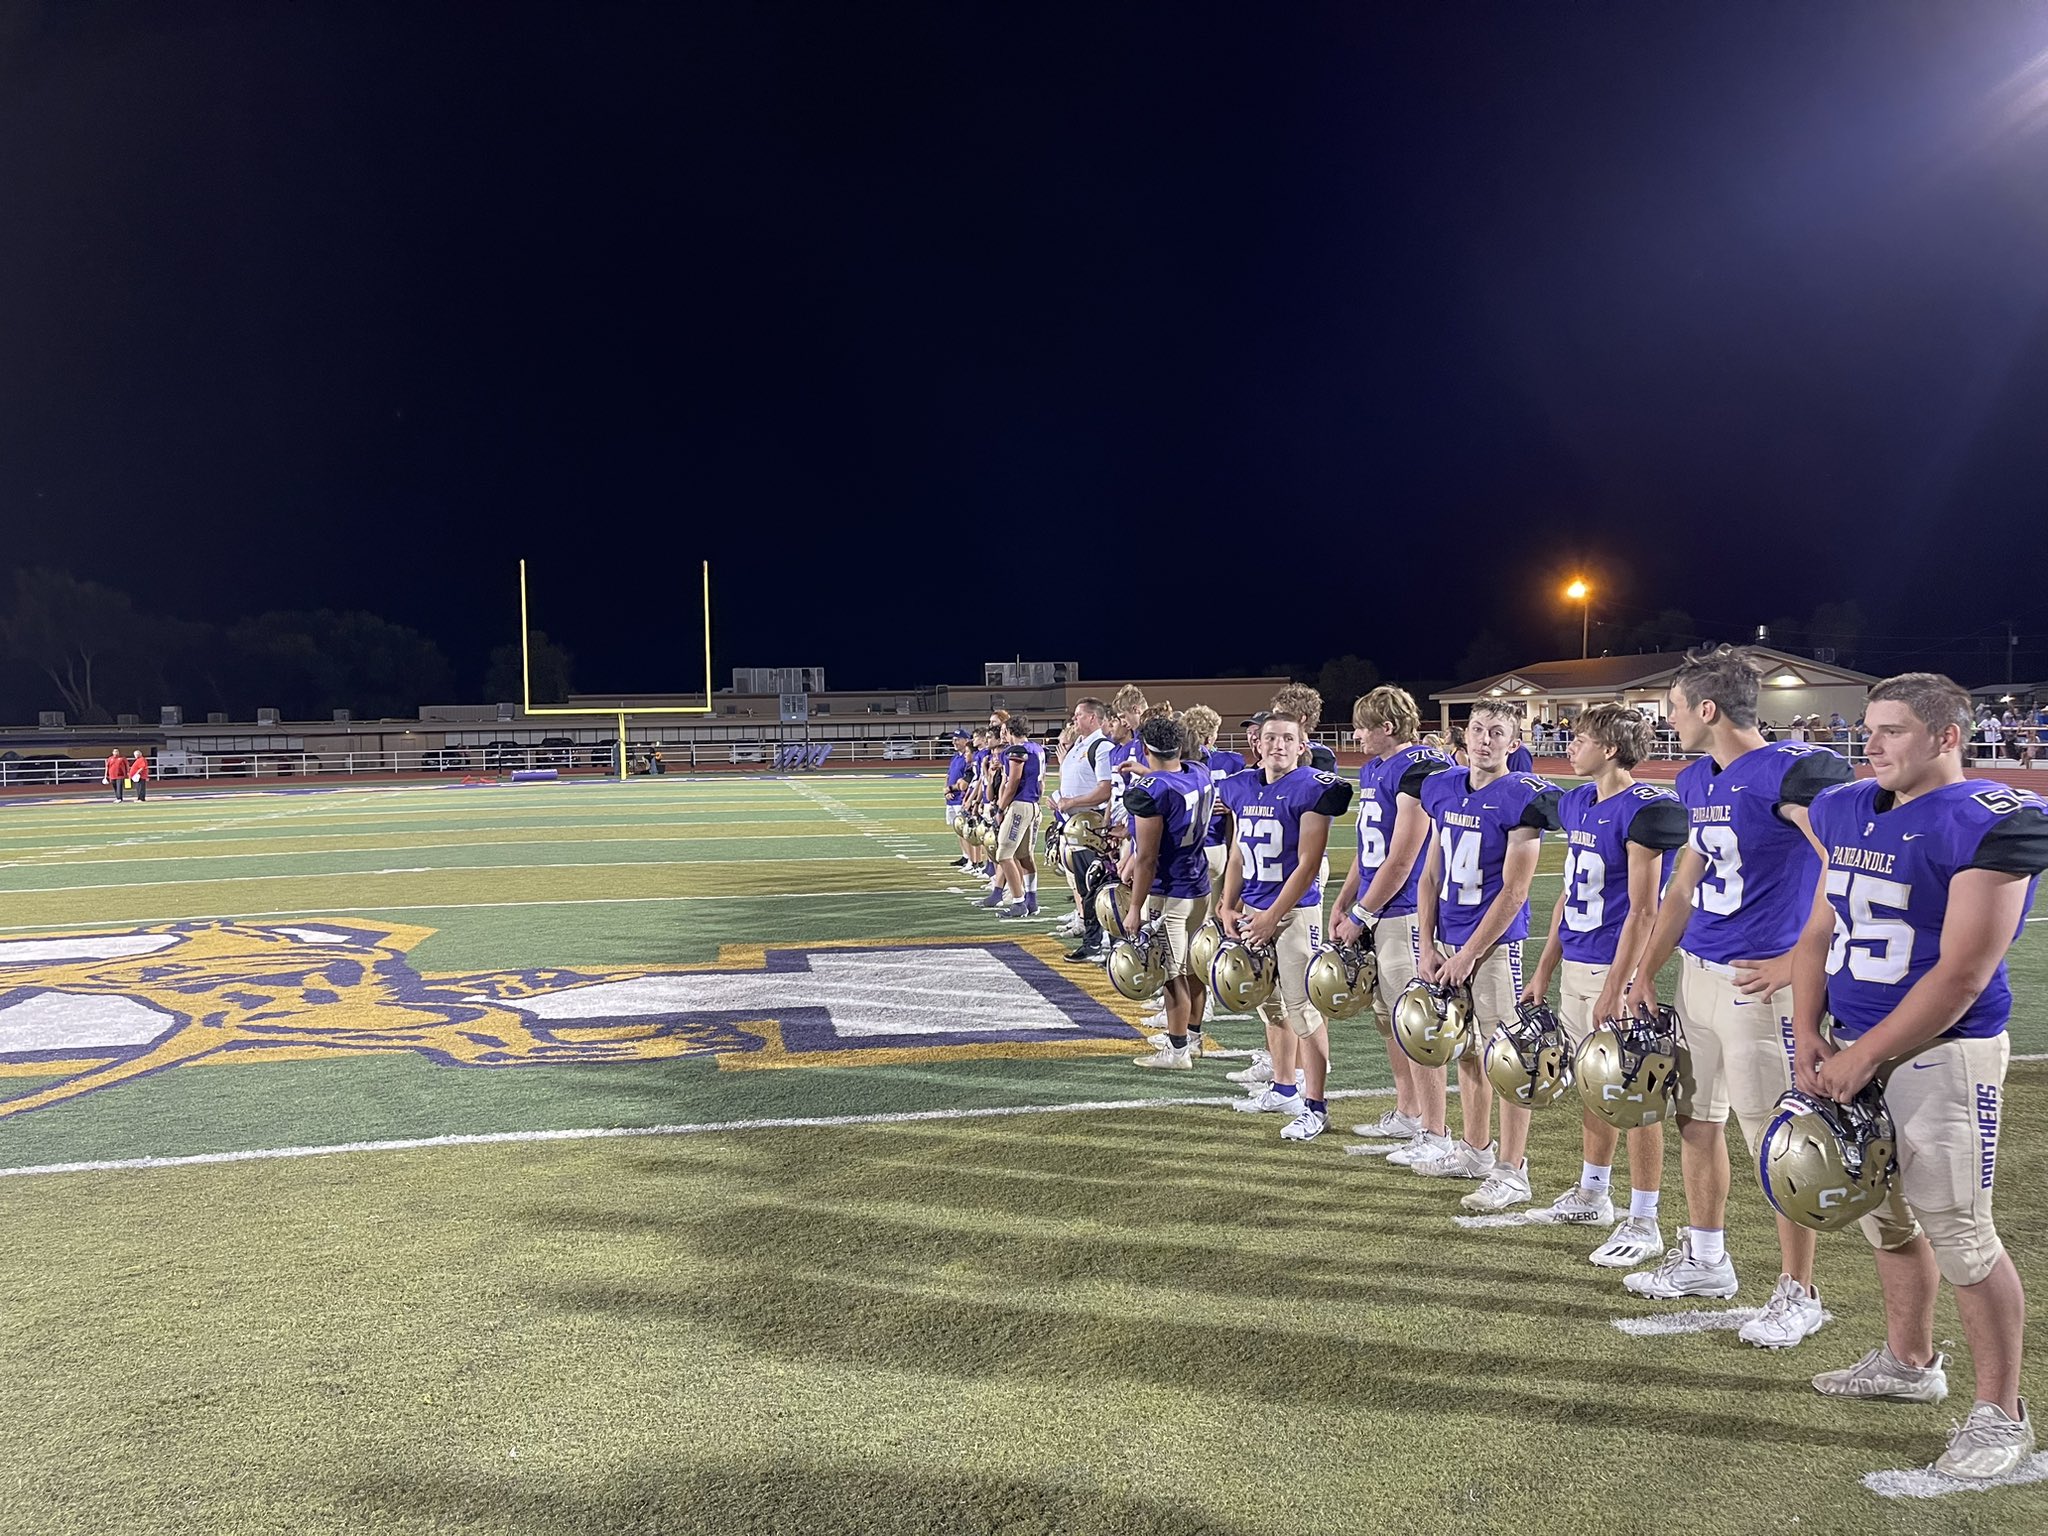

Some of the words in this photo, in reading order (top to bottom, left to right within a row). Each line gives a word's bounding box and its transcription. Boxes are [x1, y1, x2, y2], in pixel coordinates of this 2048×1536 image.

[1236, 818, 1284, 882] 62
[1356, 801, 1386, 868] 6
[1440, 826, 1484, 906] 14
[1831, 845, 1896, 875] PANHANDLE
[1825, 869, 1916, 985] 55
[1976, 1083, 1997, 1190] PANTHERS
